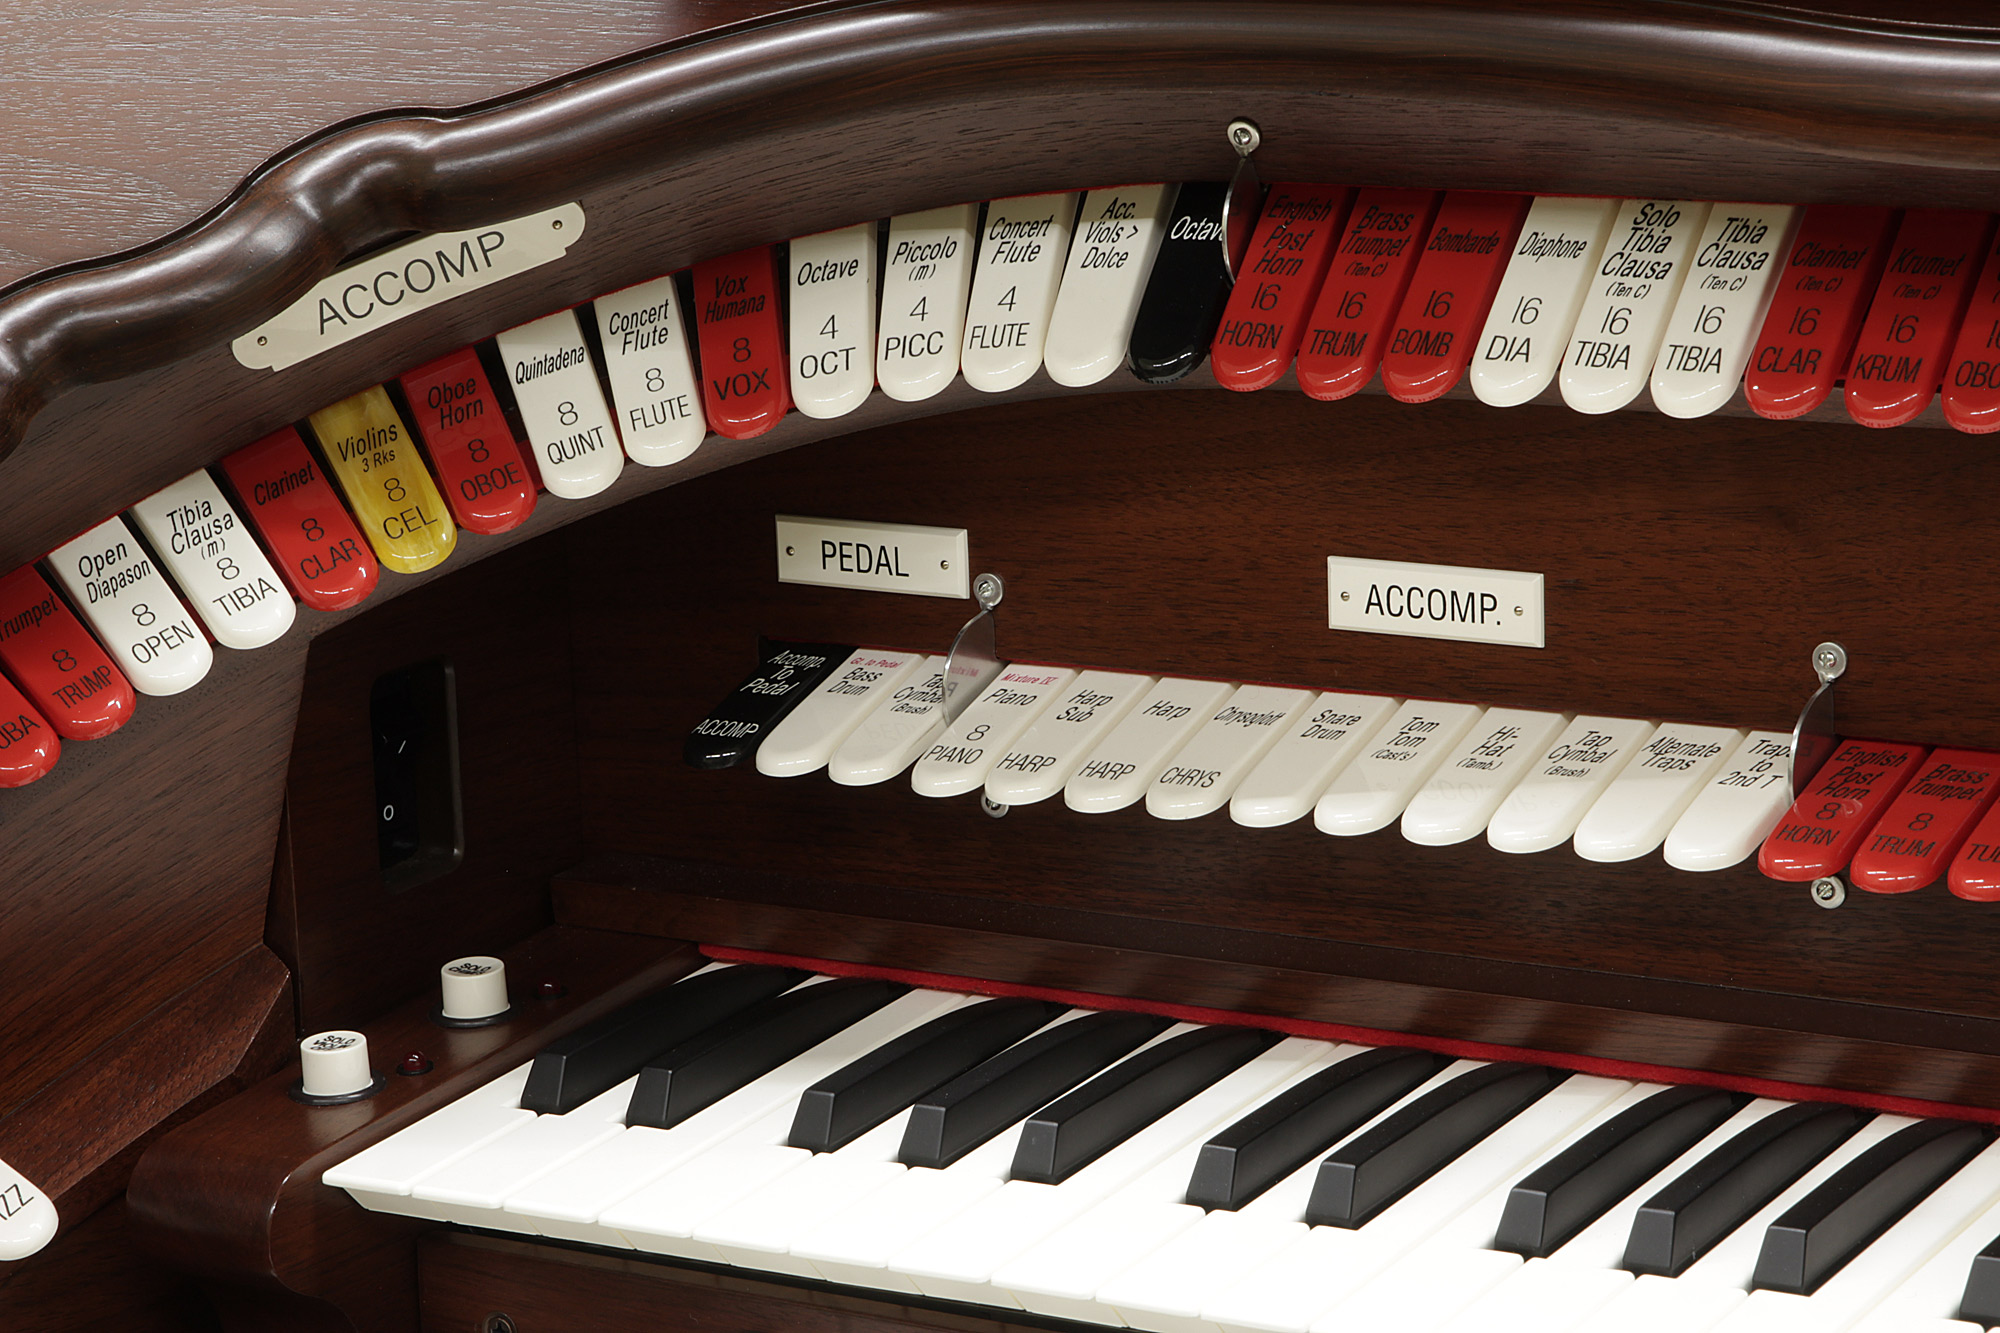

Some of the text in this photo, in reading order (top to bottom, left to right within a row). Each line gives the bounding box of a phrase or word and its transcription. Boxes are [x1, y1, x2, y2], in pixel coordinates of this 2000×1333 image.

[1101, 197, 1136, 219] Acc.
[1266, 194, 1334, 224] English
[1356, 205, 1415, 232] Brass
[1633, 203, 1681, 229] Solo
[989, 215, 1055, 241] Concert
[1085, 221, 1124, 243] Viols
[1170, 216, 1223, 241] Octav
[1263, 225, 1314, 252] Post
[1428, 226, 1499, 255] Bombarde
[1621, 227, 1672, 254] Tibia
[1716, 217, 1768, 245] Tibia
[892, 237, 958, 265] Piccolo
[990, 240, 1042, 264] Flute
[1340, 230, 1412, 258] Trumpet
[1518, 231, 1587, 263] Diaphone
[1696, 242, 1770, 271] Clausa
[1791, 242, 1870, 270] Clarinet
[1080, 247, 1128, 268] Dolce
[1253, 250, 1304, 277] Horn
[1345, 260, 1388, 278] (Ten C)
[1601, 251, 1673, 281] Clausa
[1890, 249, 1967, 276] Krumet
[318, 230, 505, 335] ACCOMP
[797, 258, 859, 286] Octave
[909, 263, 937, 282] (m)
[1701, 274, 1748, 292] (Ten C)
[1795, 275, 1843, 293] (Ten C)
[715, 275, 749, 299] Vox
[998, 286, 1017, 312] 4
[1251, 283, 1281, 310] 16
[1605, 282, 1651, 299] (Ten C)
[1893, 284, 1942, 299] (Ten C)
[703, 294, 766, 324] Humana
[909, 296, 928, 321] 4
[1337, 291, 1367, 319] 16
[1423, 290, 1454, 318] 16
[1511, 297, 1542, 325] 16
[609, 298, 670, 336] Concert
[819, 315, 839, 339] 4
[1600, 307, 1632, 335] 16
[1693, 305, 1725, 334] 16
[1788, 306, 1821, 335] 16
[1886, 314, 1919, 343] 16
[621, 325, 669, 355] Flute
[884, 331, 944, 360] PICC
[968, 322, 1030, 350] FLUTE
[1219, 320, 1283, 349] HORN
[1309, 329, 1368, 357] TRUM
[1390, 329, 1454, 357] BOMB
[732, 337, 751, 362] 8
[1485, 335, 1532, 362] DIA
[1574, 341, 1631, 370] TIBIA
[1666, 345, 1723, 374] TIBIA
[1757, 346, 1821, 374] CLAR
[515, 345, 585, 385] Quintadena
[800, 347, 856, 379] OCT
[1853, 354, 1923, 383] KRUM
[645, 367, 665, 393] 8
[713, 368, 772, 401] VOX
[427, 378, 477, 409] Oboe
[440, 397, 484, 430] Horn
[557, 401, 579, 426] 8
[629, 394, 692, 432] FLUTE
[337, 424, 398, 463] Violins
[468, 438, 490, 463] 8
[547, 426, 605, 465] QUINT
[362, 449, 396, 473] 3 Rks
[254, 461, 316, 506] Clarinet
[383, 477, 407, 502] 8
[460, 461, 522, 501] OBOE
[166, 500, 213, 532] Tibia
[382, 505, 438, 540] CEL
[170, 512, 234, 555] Clausa
[301, 518, 325, 542] 8
[78, 541, 129, 580] Open
[201, 538, 226, 560] (m)
[300, 538, 363, 580] CLAR
[821, 540, 909, 577] PEDAL
[216, 557, 240, 580] 8
[86, 559, 151, 604] Diapason
[213, 577, 278, 617] TIBIA
[1364, 583, 1502, 627] ACCOMP.
[132, 603, 156, 626] 8
[131, 620, 195, 664] OPEN
[52, 649, 77, 672] 8
[767, 649, 825, 670] Accomp.
[875, 659, 903, 669] Pedal
[770, 665, 795, 680] To
[842, 667, 883, 682] Bass
[1001, 673, 1059, 686] Mixture IV
[52, 665, 112, 709] TRUMP
[740, 677, 795, 696] Pedal
[827, 681, 870, 696] Drum
[893, 687, 943, 705] Cymba
[983, 688, 1037, 706] Piano
[1068, 689, 1113, 709] Harp
[890, 703, 933, 715] (Brush)
[1056, 706, 1094, 723] Sub
[1142, 700, 1192, 722] Harp
[1213, 706, 1286, 728] Chrysoglott
[1311, 709, 1362, 726] Snare
[691, 719, 759, 739] ACCOMP
[966, 725, 990, 741] 8
[1300, 724, 1347, 741] Drum
[1400, 716, 1440, 733] Tom
[1487, 726, 1522, 742] Hi-
[1386, 731, 1427, 748] Tom
[1471, 741, 1516, 758] Hat
[1575, 730, 1613, 748] Tap
[1640, 736, 1722, 759] Alternate
[924, 745, 984, 764] PIANO
[997, 752, 1056, 773] HARP
[1547, 745, 1618, 764] Cymbal
[1641, 752, 1696, 773] Traps
[1748, 759, 1773, 772] to
[1834, 745, 1907, 771] English
[1078, 760, 1136, 781] HARP
[1159, 766, 1221, 788] CHRYS
[1543, 765, 1591, 778] (Brush)
[1717, 771, 1784, 790] 2nd T
[1828, 765, 1884, 789] Post
[1927, 764, 1990, 784] Brass
[1815, 779, 1870, 801] Horn
[1906, 778, 1985, 801] Trumpet
[1816, 802, 1842, 821] 8
[1908, 812, 1934, 831] 8
[1775, 824, 1841, 847] HORN
[1870, 834, 1936, 857] TRUM
